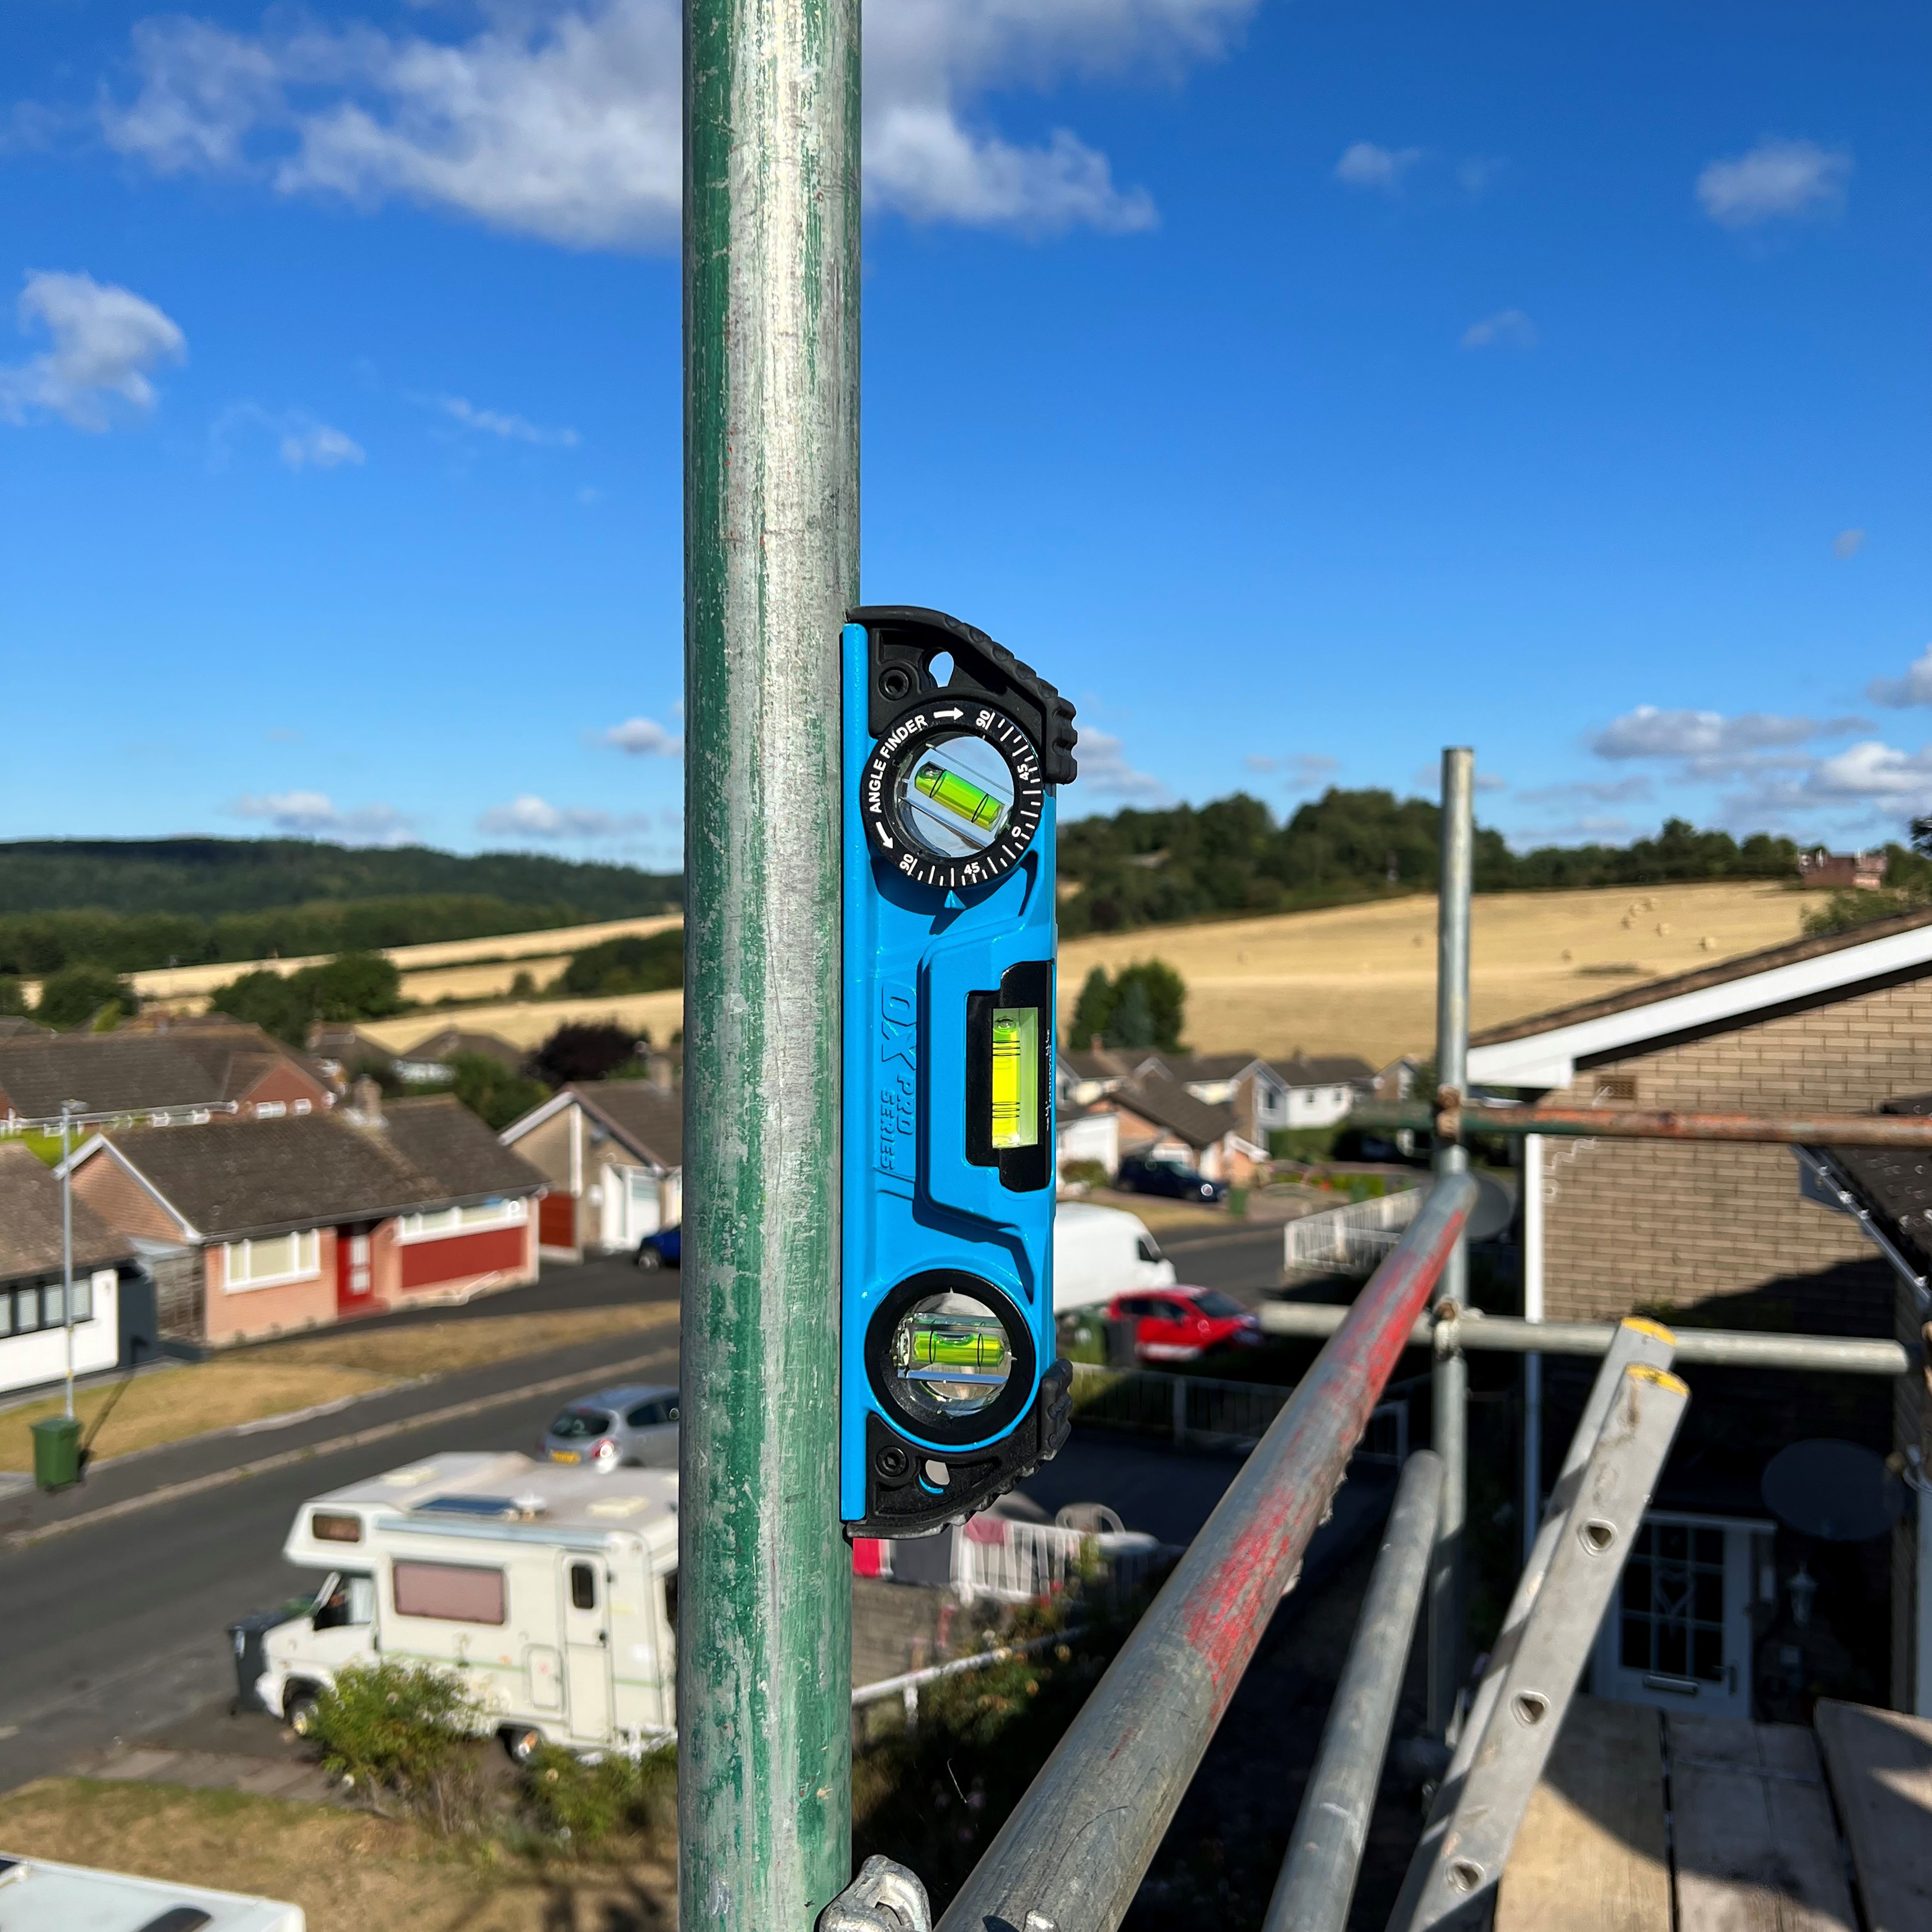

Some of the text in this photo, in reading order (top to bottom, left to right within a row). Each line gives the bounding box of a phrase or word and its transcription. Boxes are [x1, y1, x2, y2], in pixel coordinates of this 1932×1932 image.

[976, 710, 990, 728] 90
[868, 714, 928, 813] ANGLE FINDER
[1017, 764, 1029, 781] 45
[899, 853, 914, 871] 90
[964, 861, 980, 874] 45
[881, 983, 917, 1071] OX
[897, 1074, 915, 1135] PRO
[880, 1088, 896, 1170] SERIES
